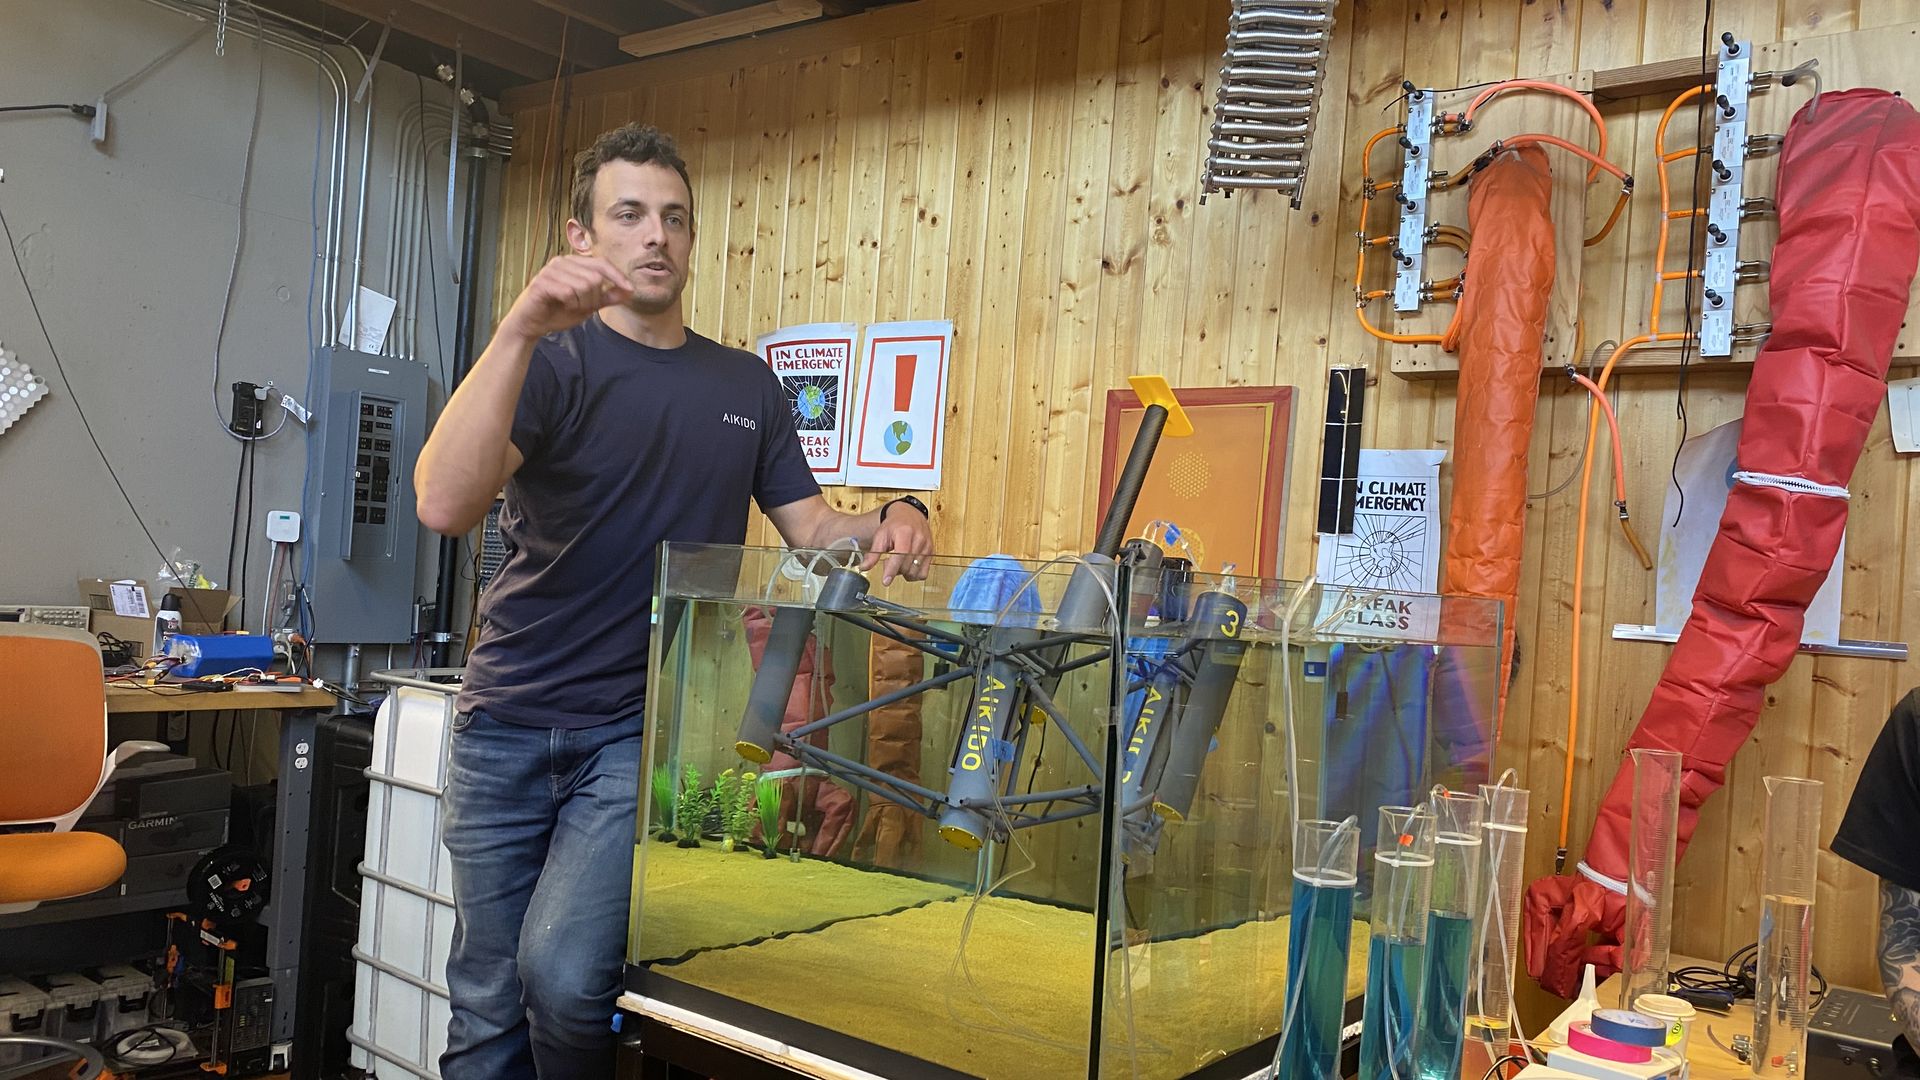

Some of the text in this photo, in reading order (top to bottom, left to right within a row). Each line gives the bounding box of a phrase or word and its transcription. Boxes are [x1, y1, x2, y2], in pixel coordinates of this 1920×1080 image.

[775, 347, 843, 360] IN CLIMATE
[777, 358, 843, 371] EMERGENCY
[722, 412, 756, 431] AIKIDO
[799, 436, 831, 446] REAK
[805, 447, 829, 458] ASS
[1356, 480, 1427, 496] N CLIMATE
[1355, 495, 1426, 512] MERGENCY
[1220, 610, 1240, 638] 3
[1344, 609, 1410, 630] GLASS
[961, 674, 1006, 771] AIKIDO
[128, 816, 179, 830] GARMIN
